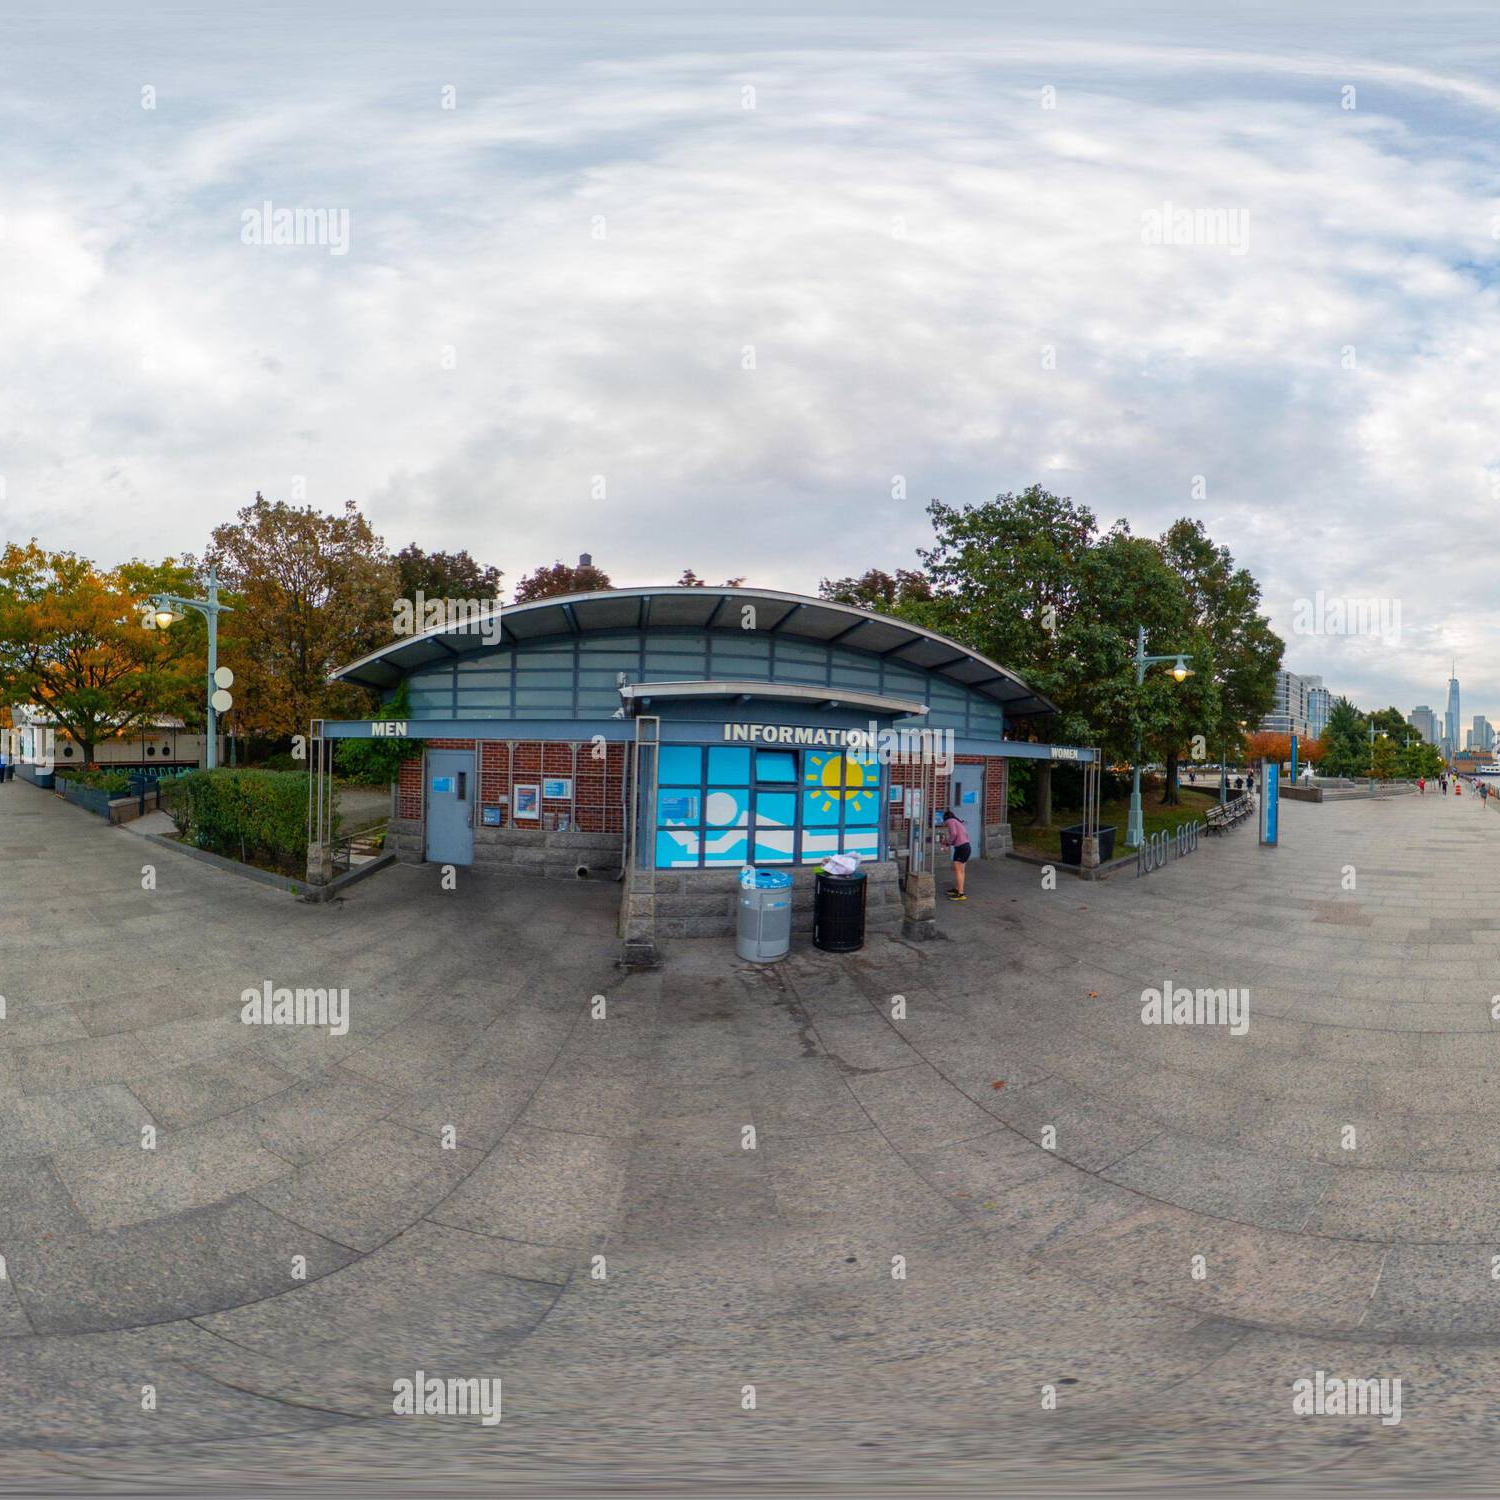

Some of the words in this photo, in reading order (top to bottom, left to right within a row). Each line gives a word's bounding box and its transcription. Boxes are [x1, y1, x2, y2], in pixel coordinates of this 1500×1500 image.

[372, 721, 407, 737] MEN
[724, 723, 874, 747] INFORMATION
[1051, 747, 1078, 759] WOMEN
